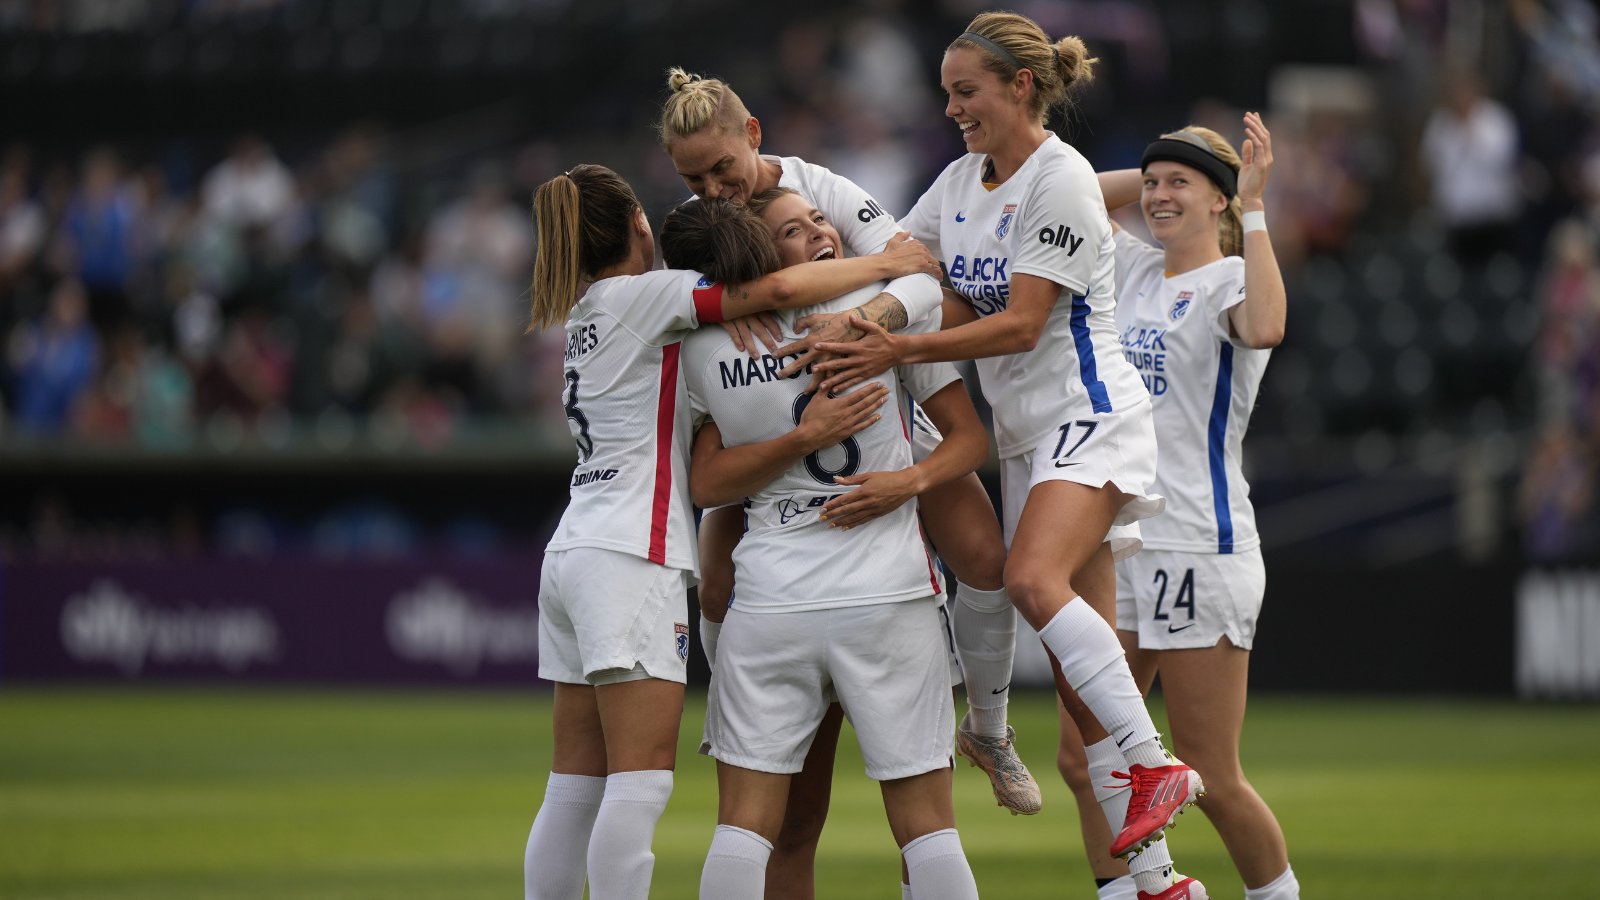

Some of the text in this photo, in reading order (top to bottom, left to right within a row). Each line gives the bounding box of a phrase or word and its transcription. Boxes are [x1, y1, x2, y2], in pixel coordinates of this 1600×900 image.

[857, 199, 885, 223] all
[1038, 224, 1085, 258] ally
[949, 254, 1008, 282] BLACK
[565, 323, 599, 361] RNES
[562, 367, 594, 464] 3
[791, 389, 862, 487] 8
[1050, 419, 1099, 460] 17
[1152, 567, 1196, 621] 24
